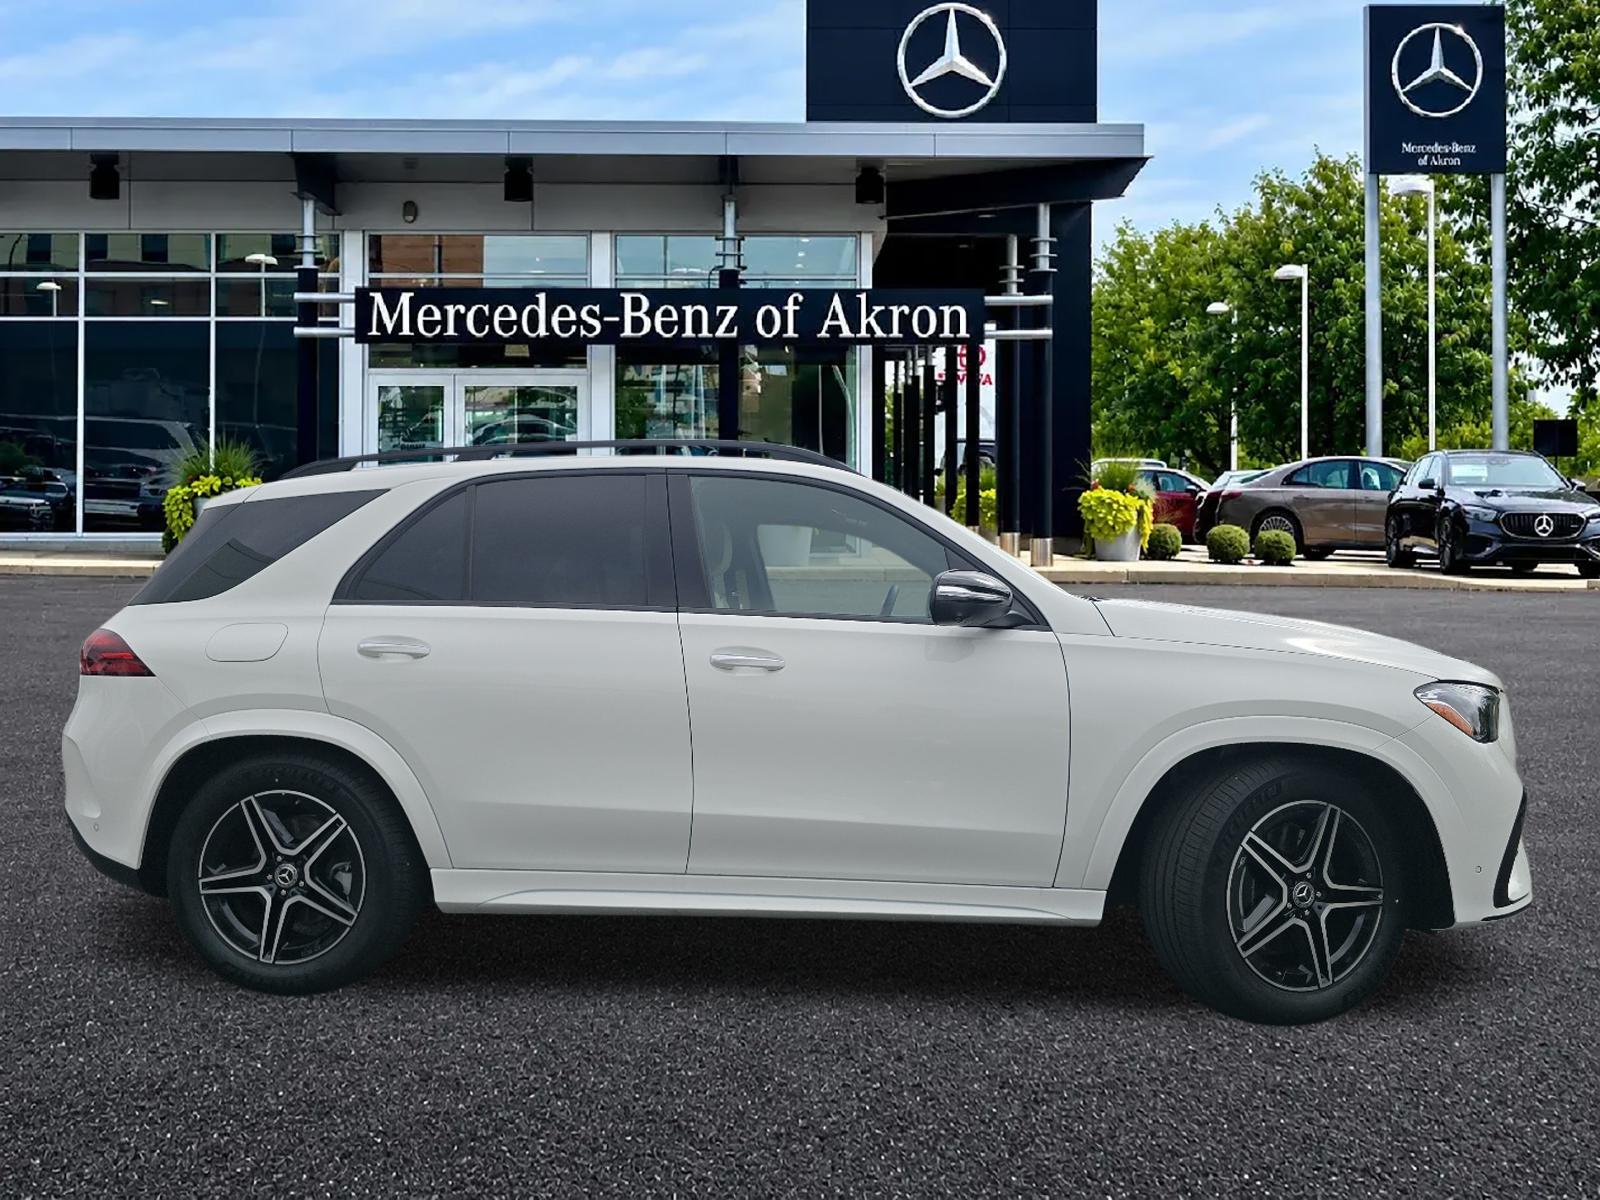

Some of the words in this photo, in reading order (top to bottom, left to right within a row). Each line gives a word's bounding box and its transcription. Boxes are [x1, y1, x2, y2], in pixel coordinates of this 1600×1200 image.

[1401, 141, 1477, 154] Mercedes-Benz
[1417, 154, 1429, 166] of
[1429, 155, 1461, 166] Akron
[366, 291, 738, 338] Mercedes-Benz
[755, 291, 804, 338] of
[816, 291, 971, 338] Akron
